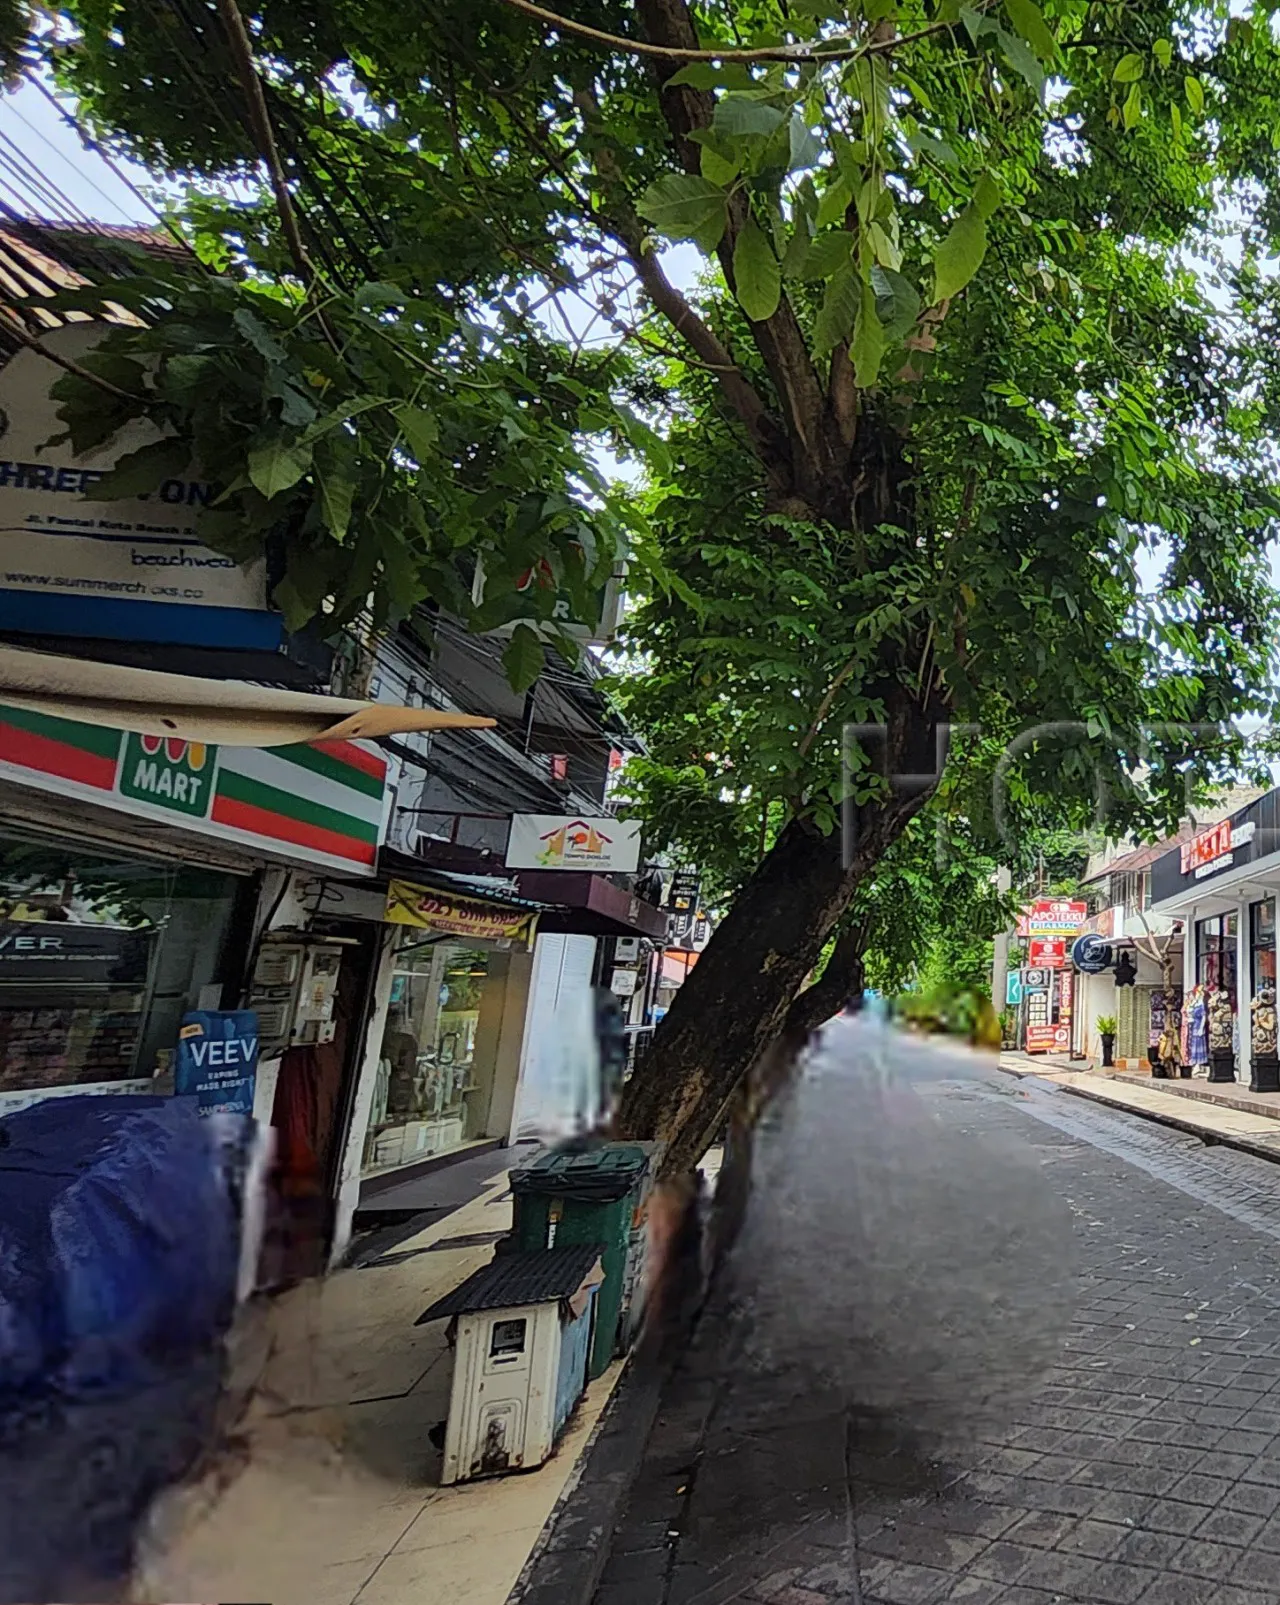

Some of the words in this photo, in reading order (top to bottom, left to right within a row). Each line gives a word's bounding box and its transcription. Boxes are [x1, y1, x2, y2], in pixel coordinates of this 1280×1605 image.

[134, 761, 203, 805] MART
[1032, 912, 1086, 922] APOTEKKU
[190, 1037, 258, 1067] VEEV
